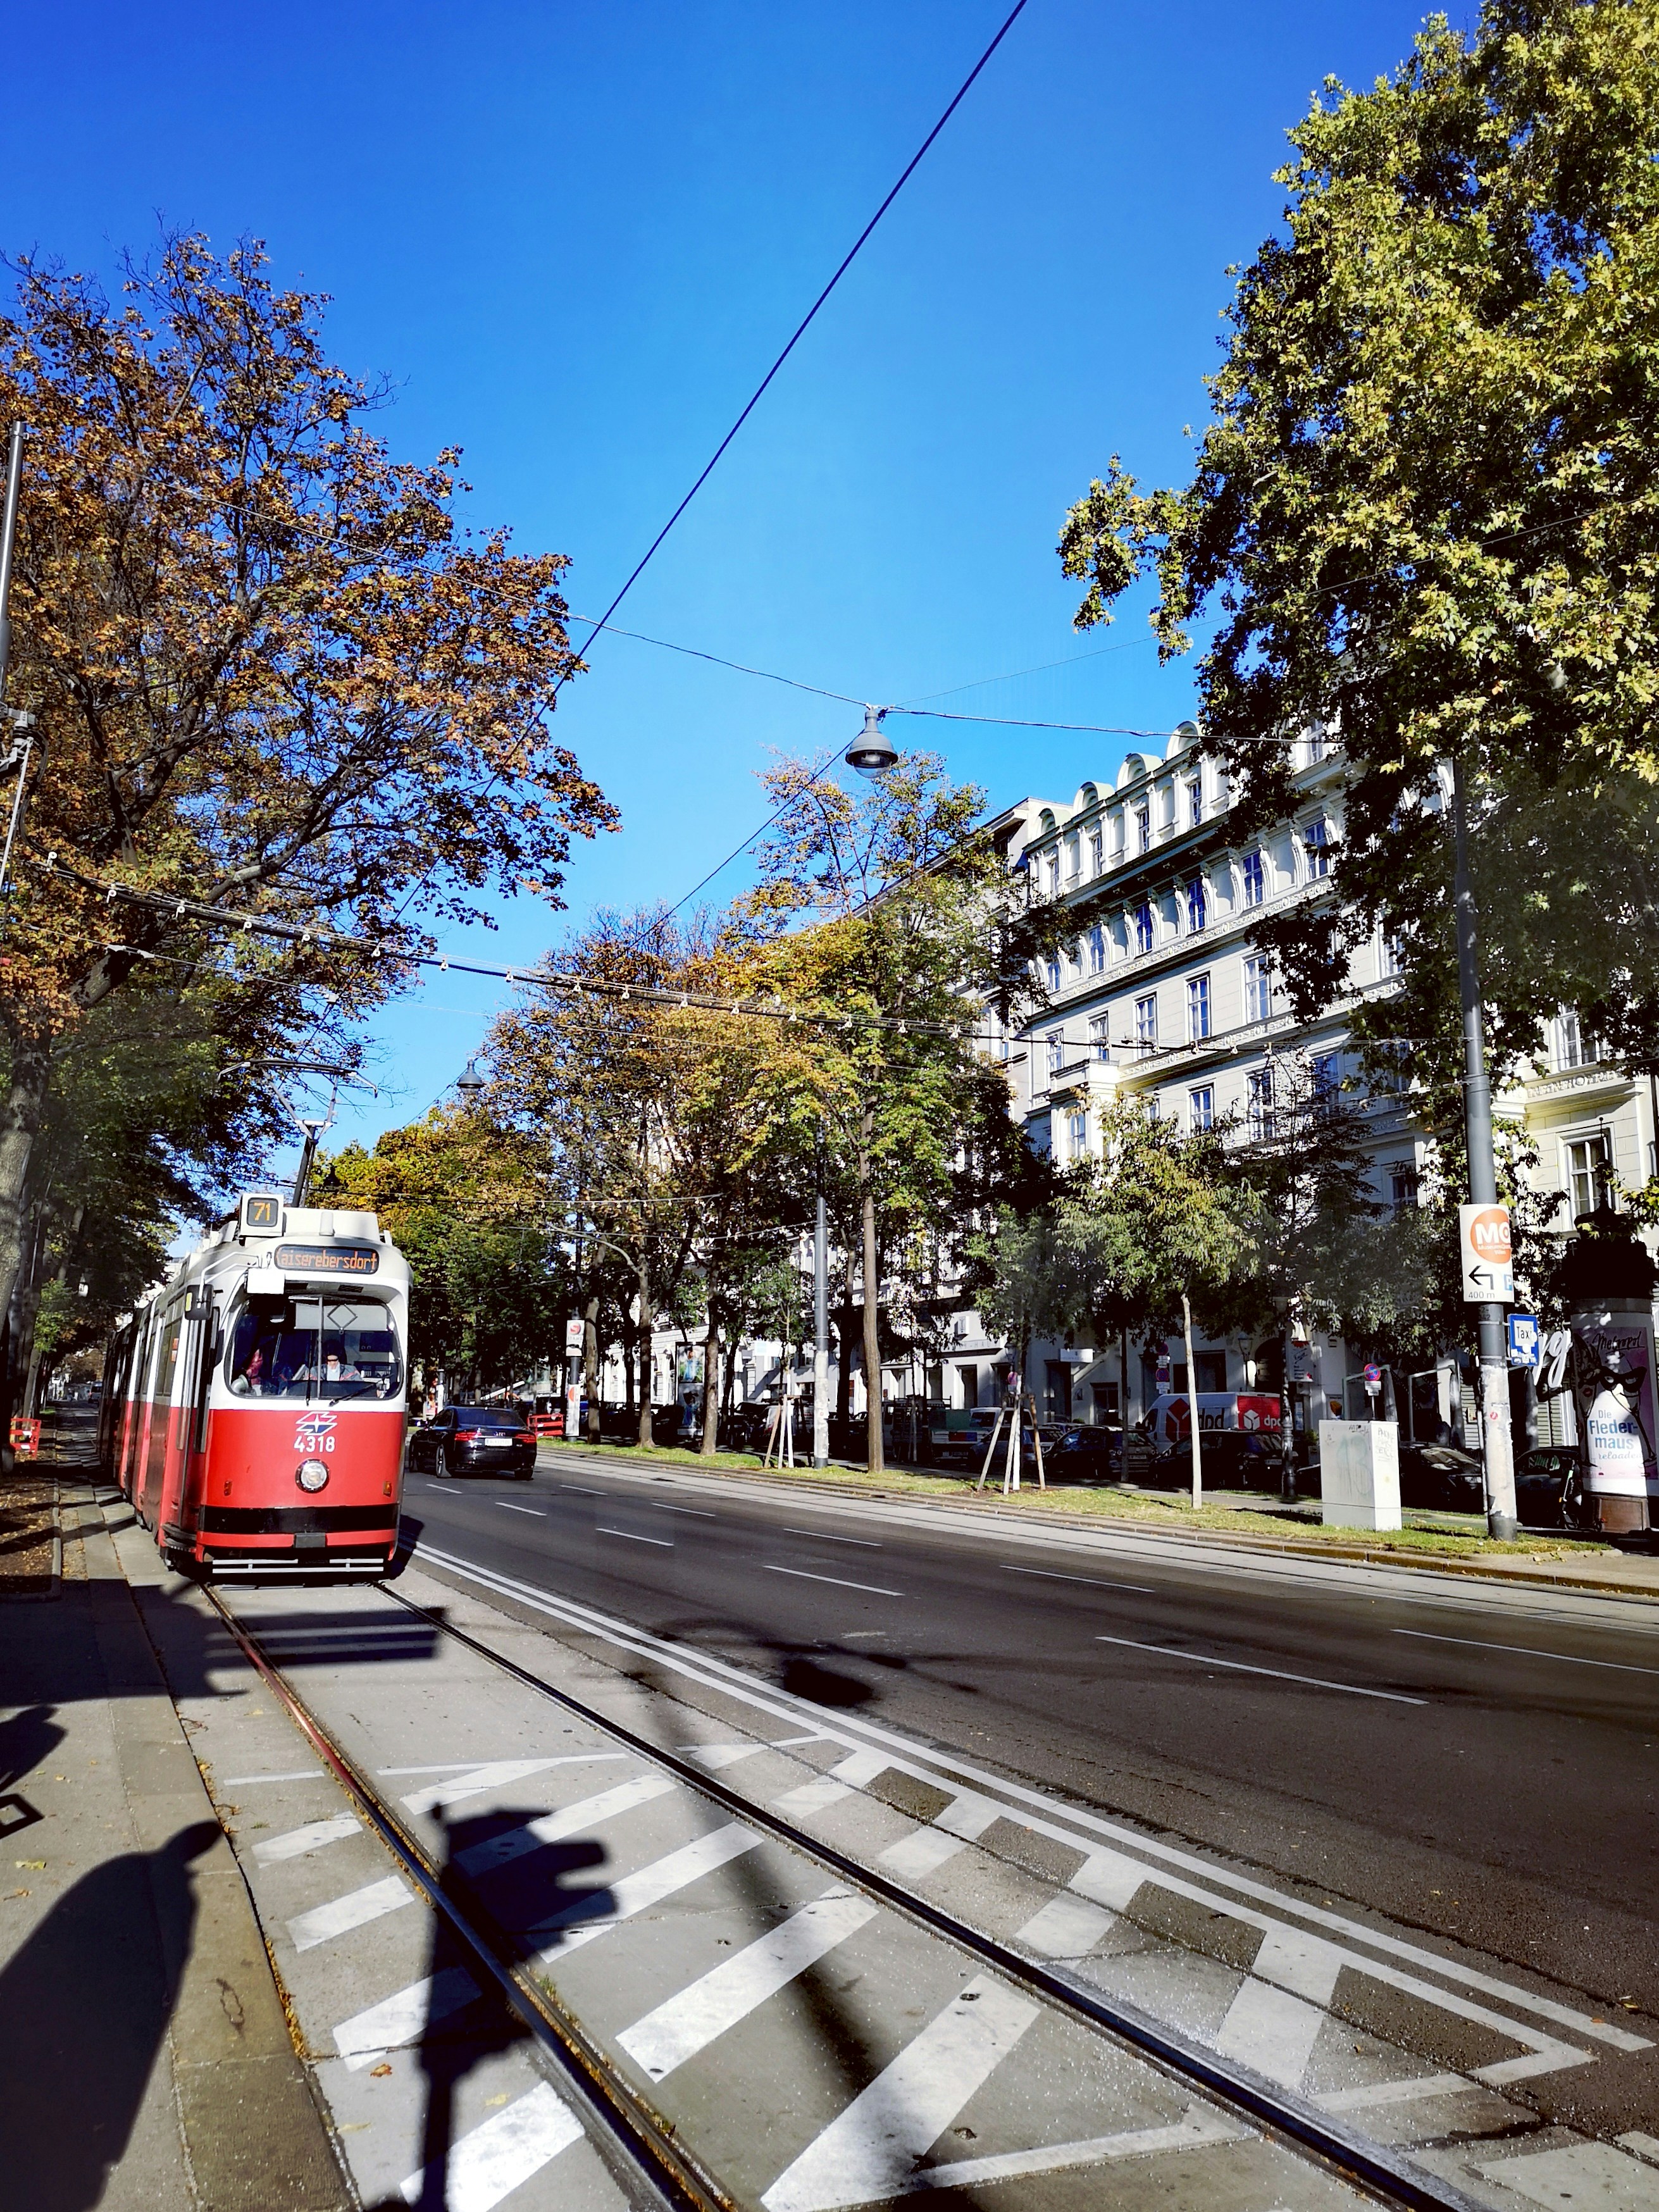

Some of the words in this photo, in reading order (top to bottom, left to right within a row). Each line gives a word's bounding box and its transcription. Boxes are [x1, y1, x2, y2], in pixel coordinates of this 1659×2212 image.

[254, 1202, 271, 1221] 71
[1592, 1331, 1642, 1353] Metropol
[1598, 1410, 1612, 1419] Die
[1589, 1419, 1638, 1434] Fleder-
[294, 1435, 335, 1453] 4318
[1594, 1437, 1635, 1449] maus
